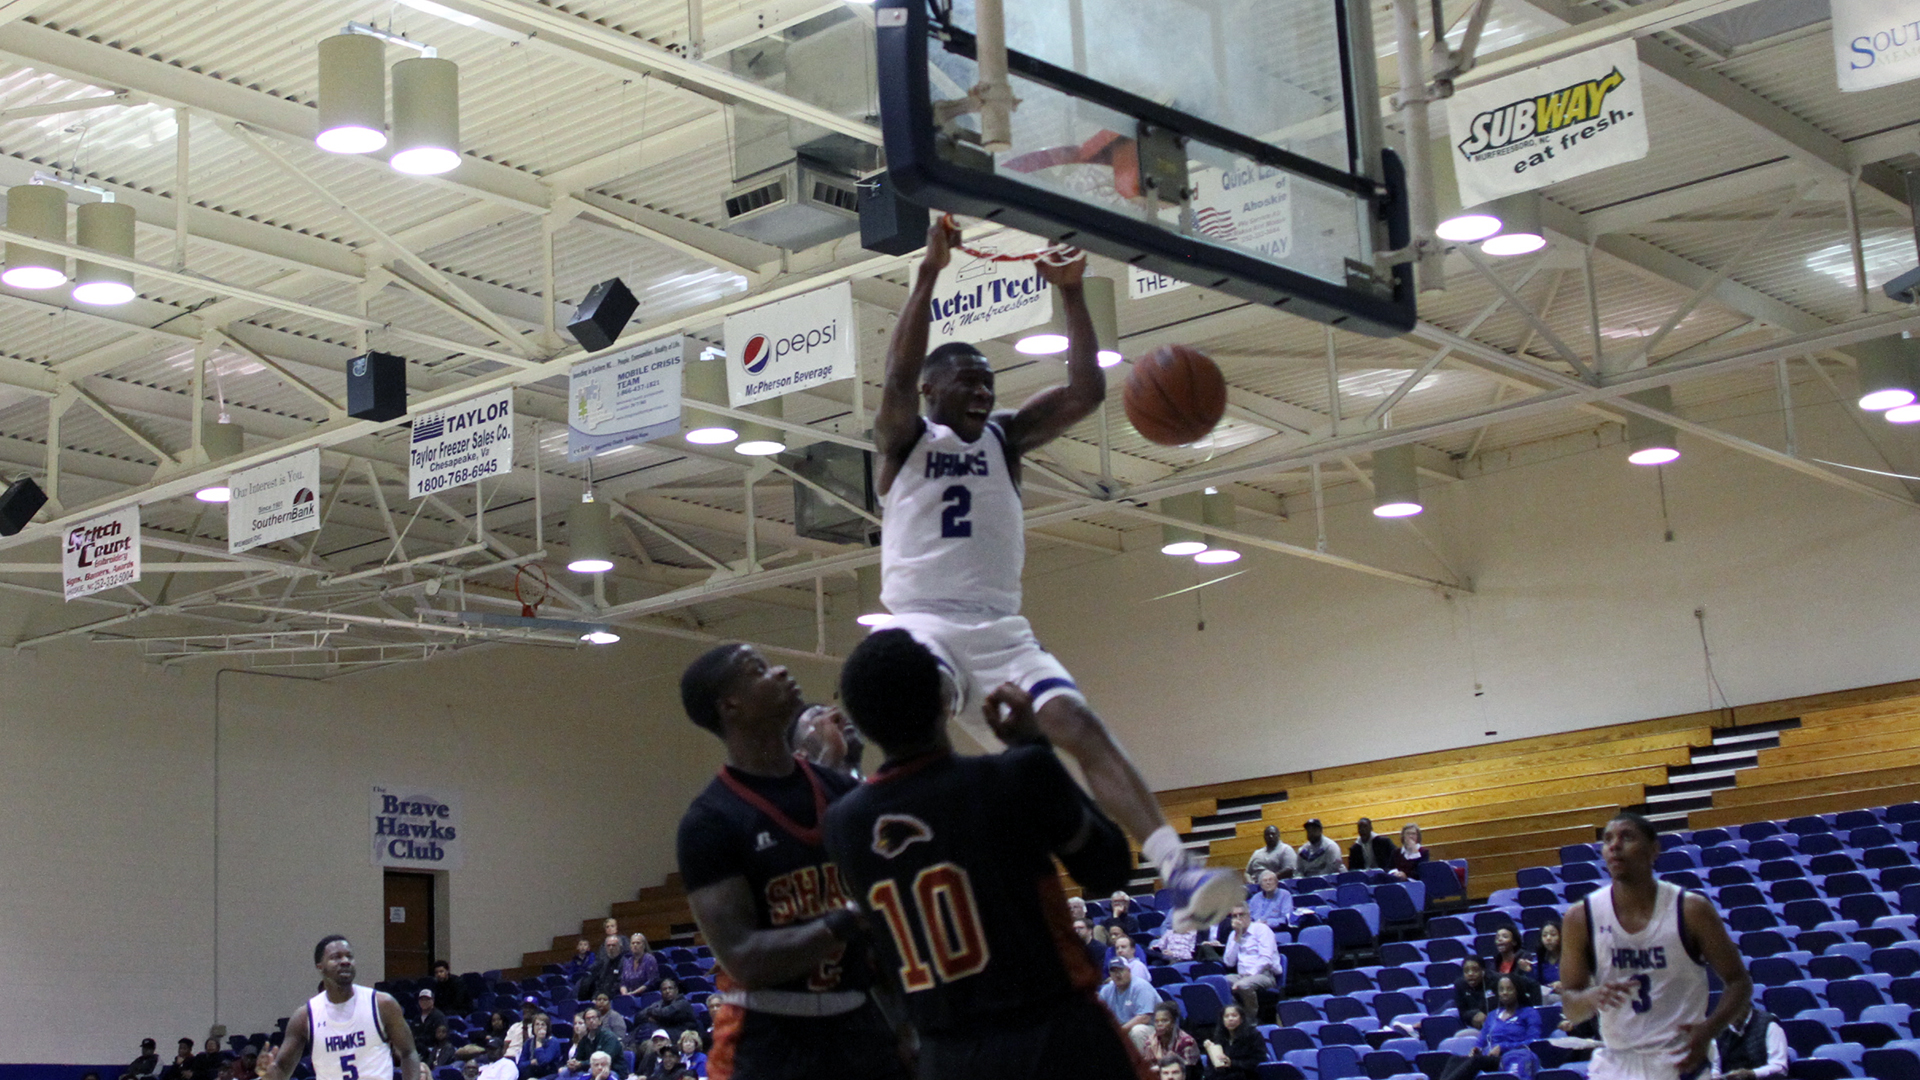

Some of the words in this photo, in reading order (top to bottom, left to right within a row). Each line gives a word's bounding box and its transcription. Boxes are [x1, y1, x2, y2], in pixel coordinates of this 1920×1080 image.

[1458, 66, 1626, 161] SUBWAY
[1475, 138, 1537, 162] MURFREESBORO,
[1539, 135, 1551, 144] NC
[1514, 146, 1555, 174] eat
[1560, 109, 1634, 150] fresh.
[1222, 165, 1255, 191] Quick
[1275, 176, 1287, 189] of
[1243, 192, 1288, 213] Ahoskie
[1136, 274, 1168, 293] THE
[959, 294, 1041, 327] Murfreesboro
[775, 319, 837, 362] pepsi
[617, 365, 649, 380] MOBILE
[651, 356, 681, 371] CRISIS
[745, 375, 792, 397] McPherson
[794, 364, 833, 384] Beverage
[617, 377, 640, 389] TEAM
[447, 400, 509, 433] TAYLOR
[411, 446, 437, 468] Taylor
[439, 439, 470, 459] Freezer
[472, 429, 495, 449] Sales
[496, 424, 511, 441] Co.
[429, 452, 479, 472] Chesapeake,
[480, 447, 490, 458] Va
[417, 459, 498, 493] 1800-768-6945
[924, 450, 990, 479] HAWKS
[232, 487, 248, 500] Our
[249, 478, 277, 495] Interest
[279, 474, 286, 485] is
[287, 470, 305, 482] You.
[251, 503, 315, 531] SouthernBank
[941, 484, 972, 538] 2
[67, 520, 122, 554] Stitch
[78, 536, 131, 568] Count
[381, 794, 450, 818] Brave
[375, 816, 456, 841] Hawks
[388, 839, 445, 861] Club
[765, 861, 852, 926] SHA
[868, 861, 991, 994] 10
[1611, 946, 1668, 970] HAWKS
[1630, 973, 1653, 1014] 3
[325, 1030, 366, 1053] HAWKS
[339, 1054, 359, 1080] 5
